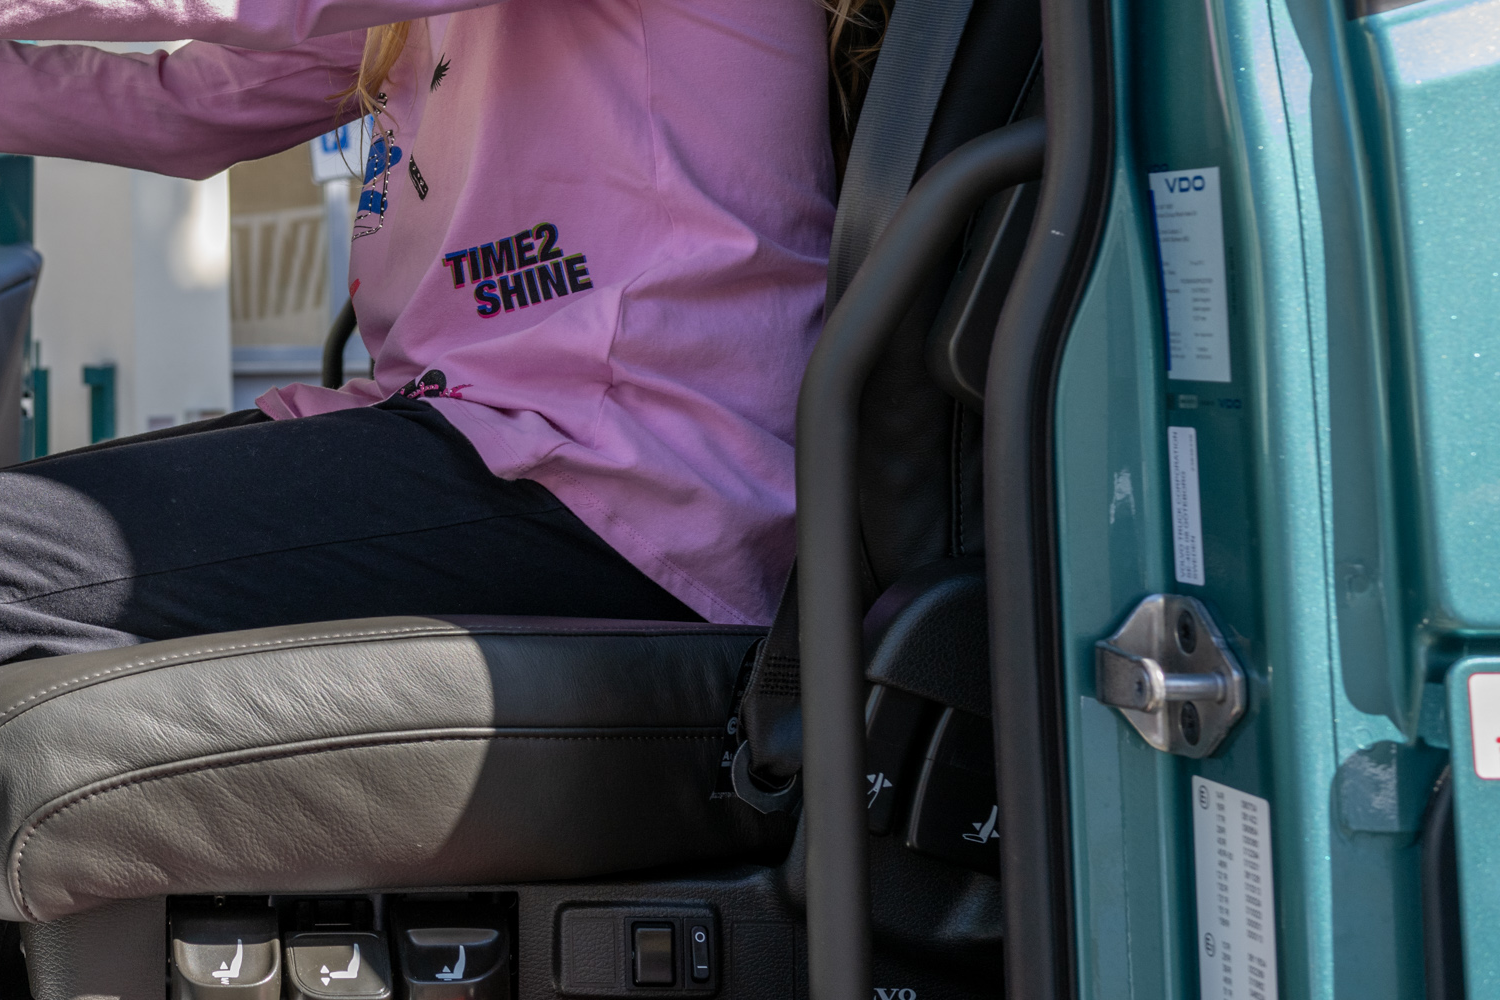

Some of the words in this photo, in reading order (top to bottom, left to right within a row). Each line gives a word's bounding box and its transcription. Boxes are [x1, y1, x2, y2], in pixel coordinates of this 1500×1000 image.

[1165, 175, 1205, 194] VDO
[442, 222, 564, 290] TIME2
[473, 253, 594, 319] SHINE
